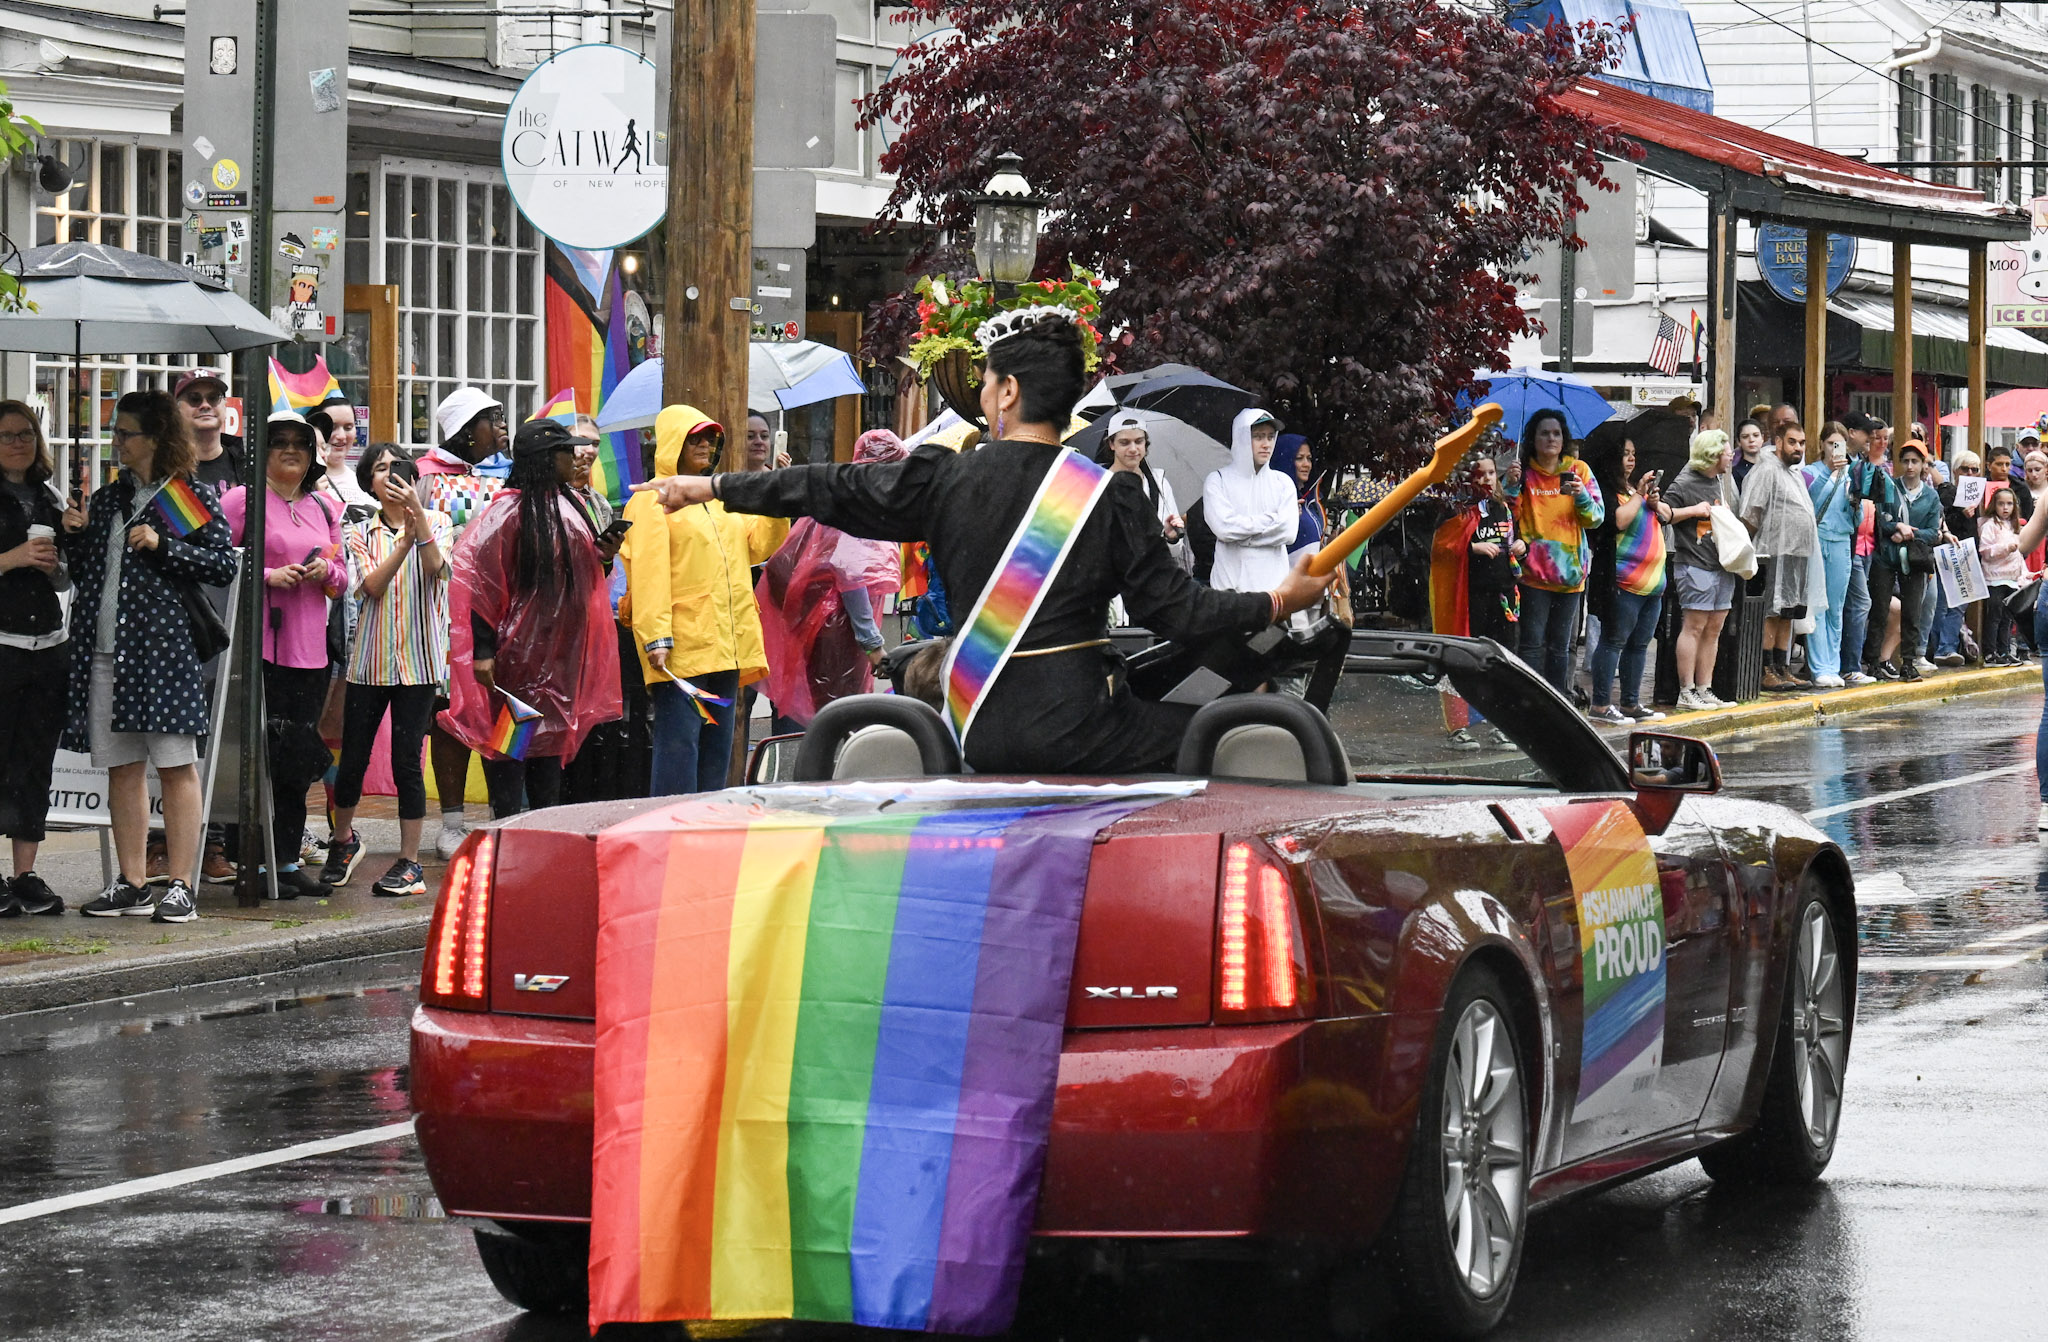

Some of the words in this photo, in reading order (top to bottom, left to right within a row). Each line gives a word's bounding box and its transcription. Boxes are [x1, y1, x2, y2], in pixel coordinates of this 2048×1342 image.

[519, 107, 547, 127] the
[553, 180, 568, 188] OF
[589, 180, 614, 188] NEW
[634, 180, 666, 188] HOPE
[1776, 252, 1834, 264] BAKY
[292, 265, 320, 275] EAMS
[1989, 259, 2020, 272] MOO
[1996, 309, 2026, 323] ICE
[1536, 488, 1554, 496] Penn
[1964, 492, 1980, 502] hope
[1951, 558, 1965, 586] FAIRNESS
[1960, 587, 1969, 598] ACT
[1582, 883, 1654, 927] #SHAWMUT
[1594, 920, 1661, 982] PROUD
[1085, 986, 1178, 999] XLR
